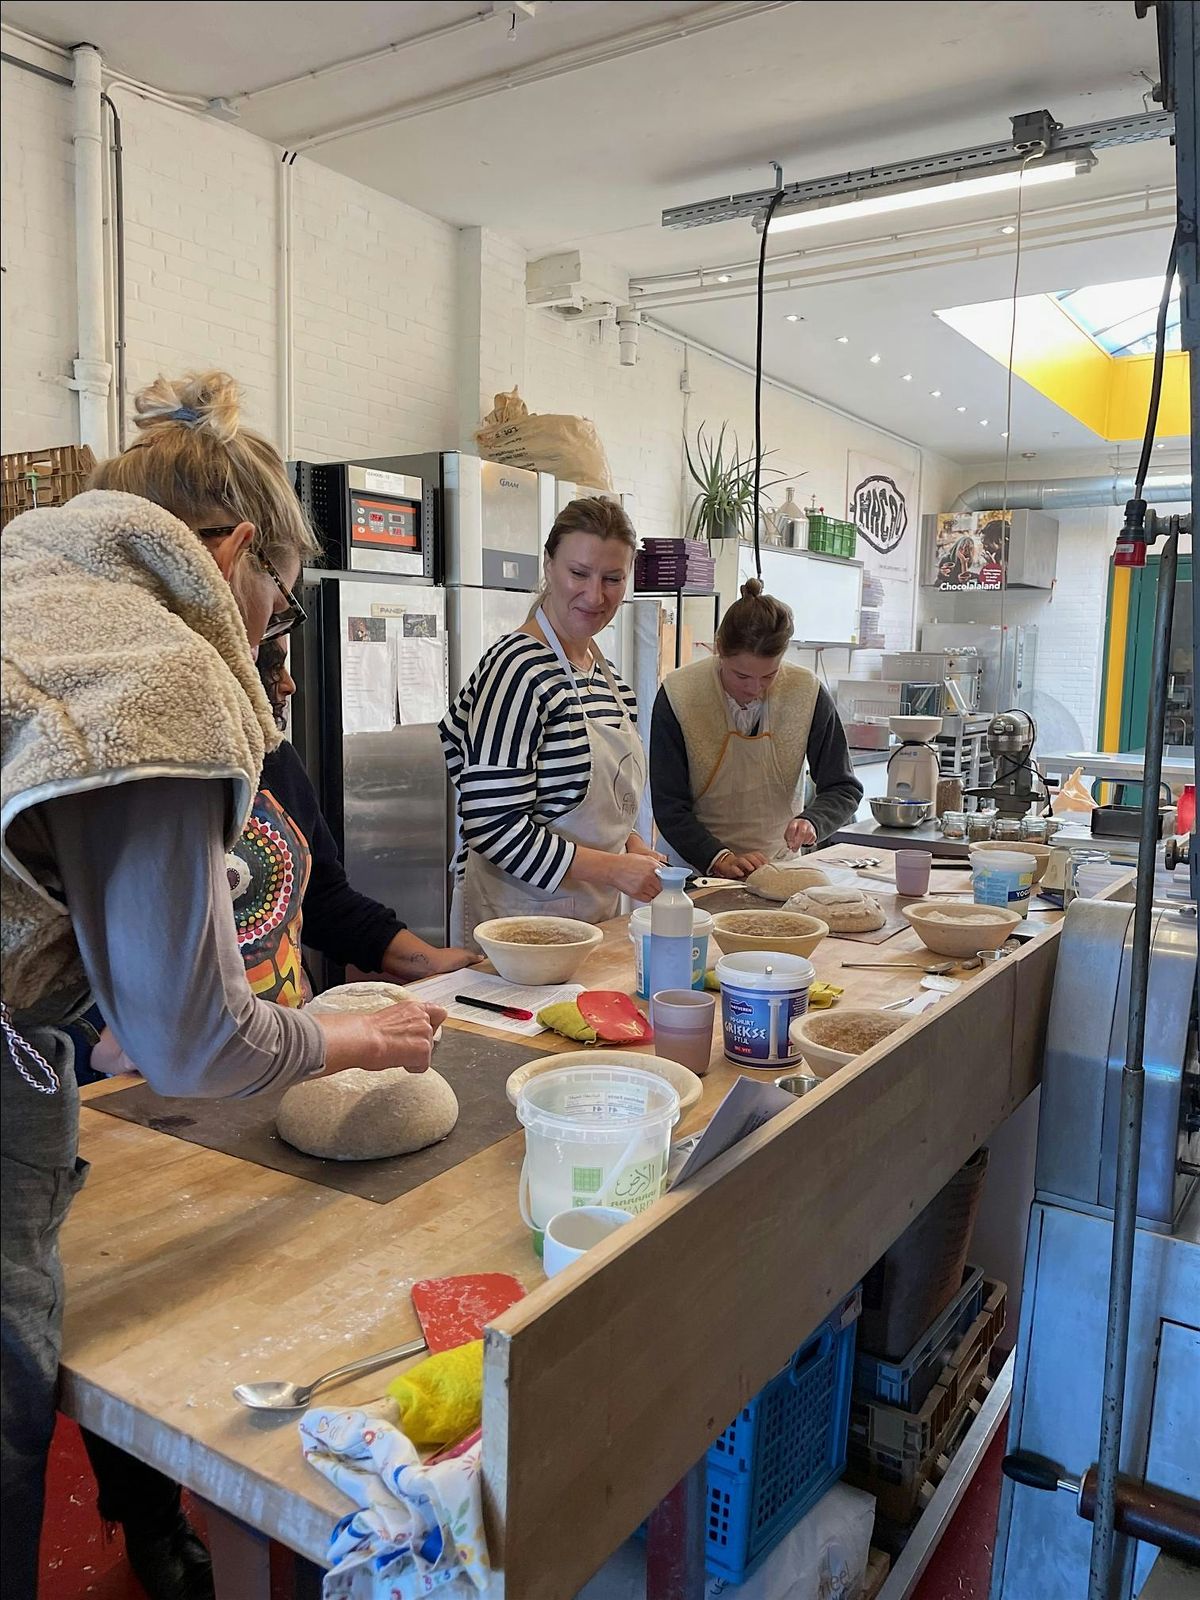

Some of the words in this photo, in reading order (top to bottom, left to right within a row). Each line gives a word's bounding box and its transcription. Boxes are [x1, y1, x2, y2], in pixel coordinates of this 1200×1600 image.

[940, 581, 1001, 591] Chocolalaland
[724, 1021, 767, 1039] GRIEKSE
[734, 1035, 749, 1045] STIJL
